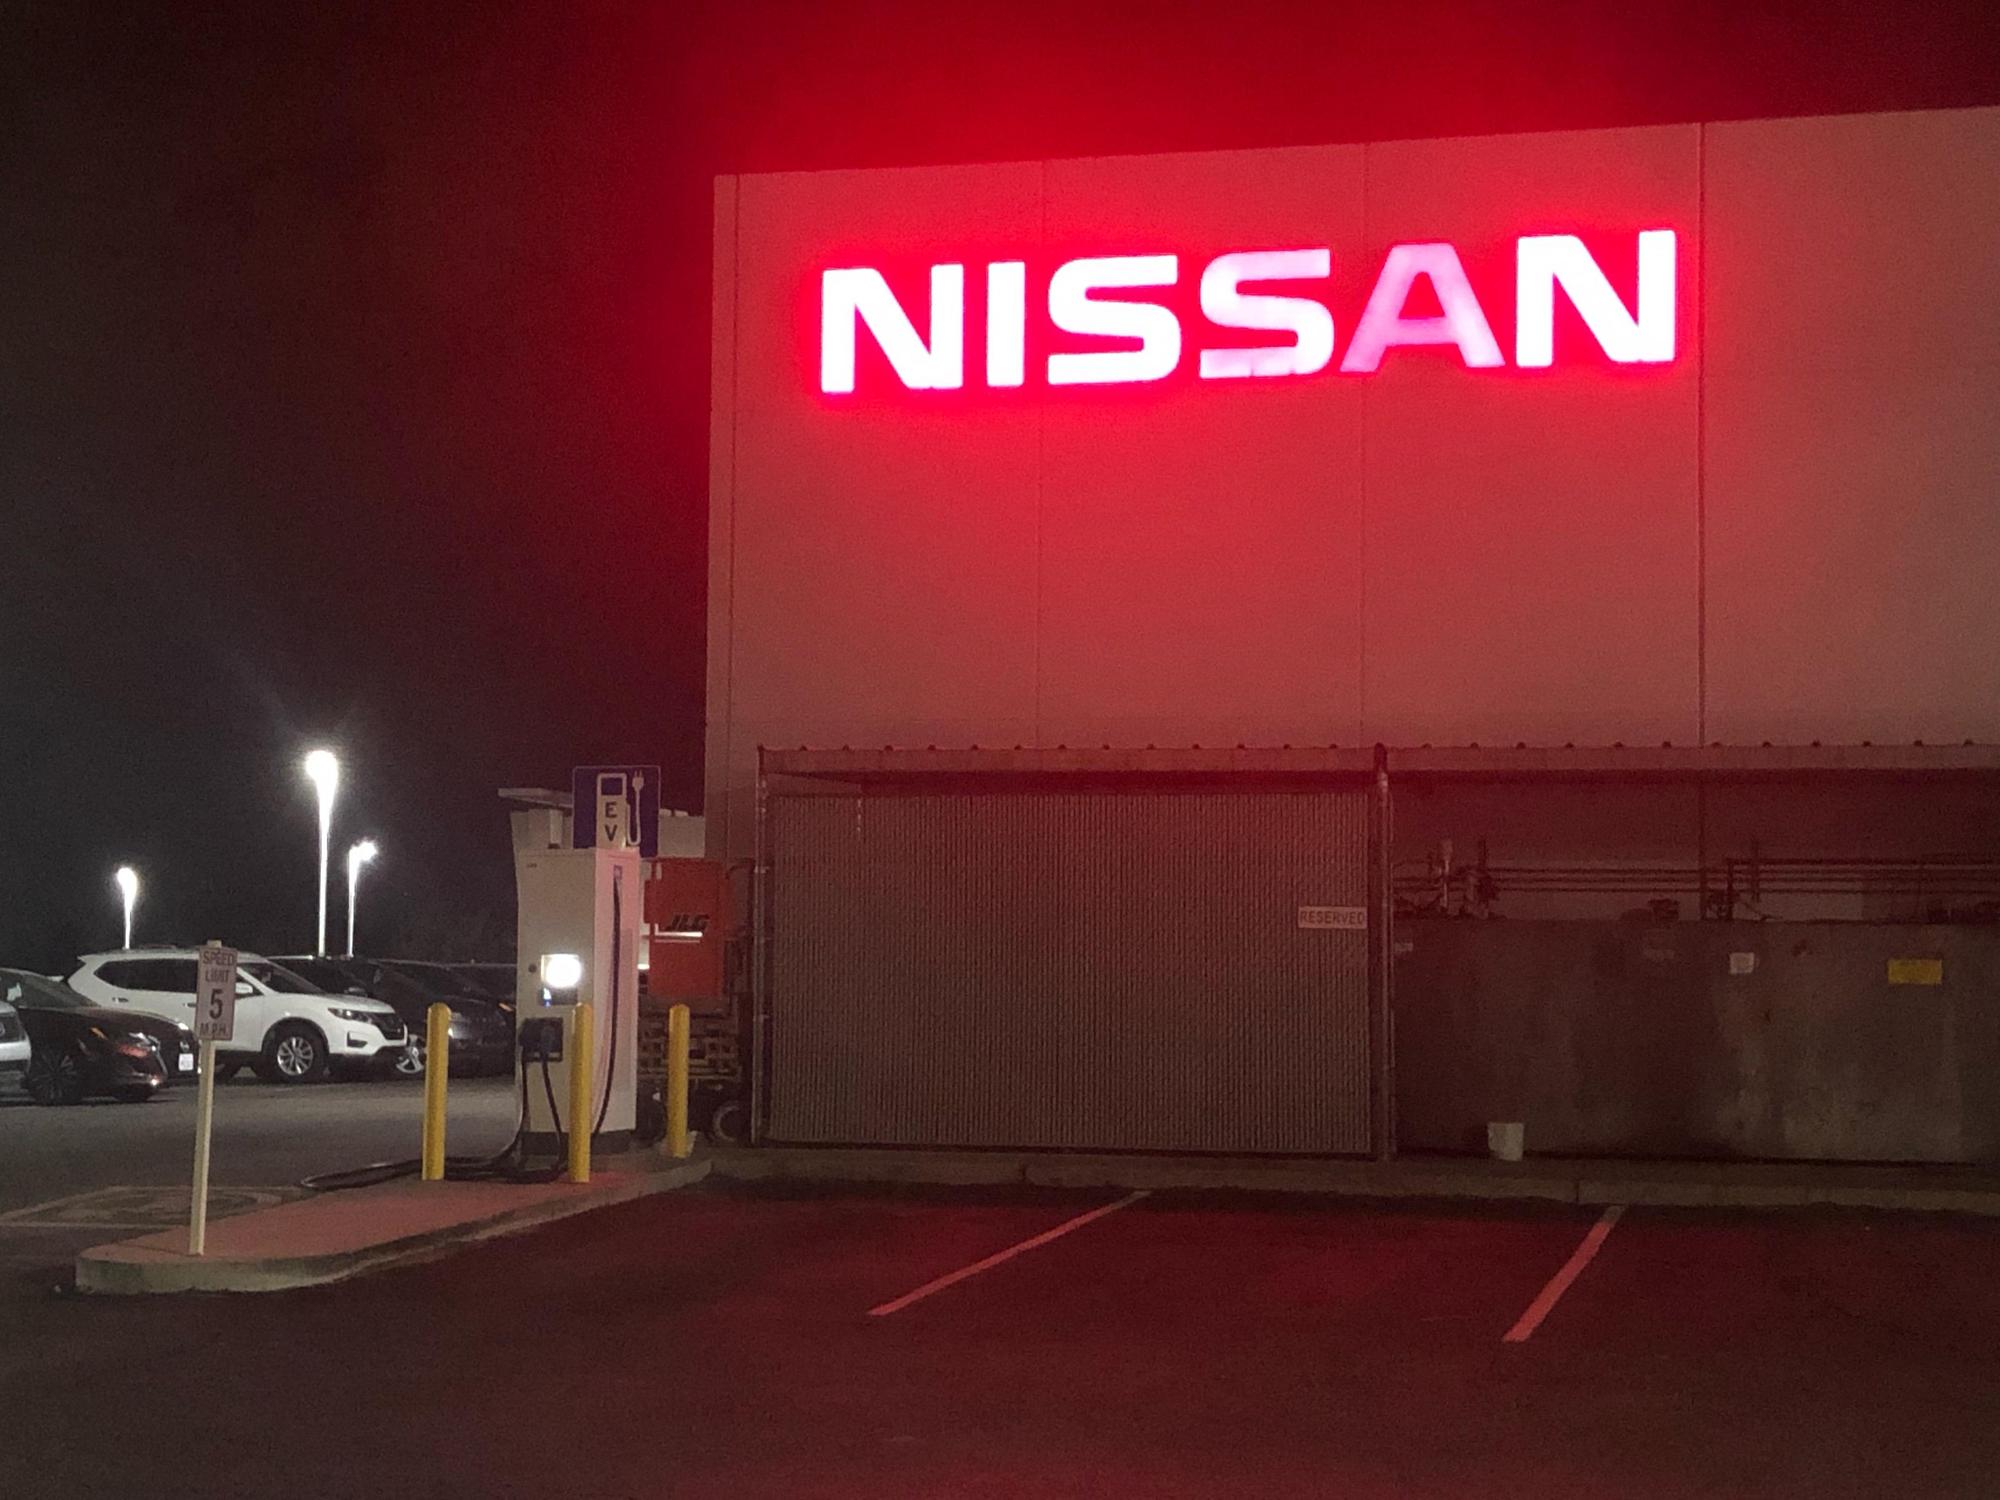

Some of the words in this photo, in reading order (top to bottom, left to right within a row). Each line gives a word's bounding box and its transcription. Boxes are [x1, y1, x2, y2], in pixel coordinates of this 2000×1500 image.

[819, 228, 1678, 395] NISSAN
[1299, 910, 1365, 925] RESERVED
[203, 950, 234, 966] SPEED
[205, 968, 230, 983] LIMIT
[209, 988, 223, 1019] 5
